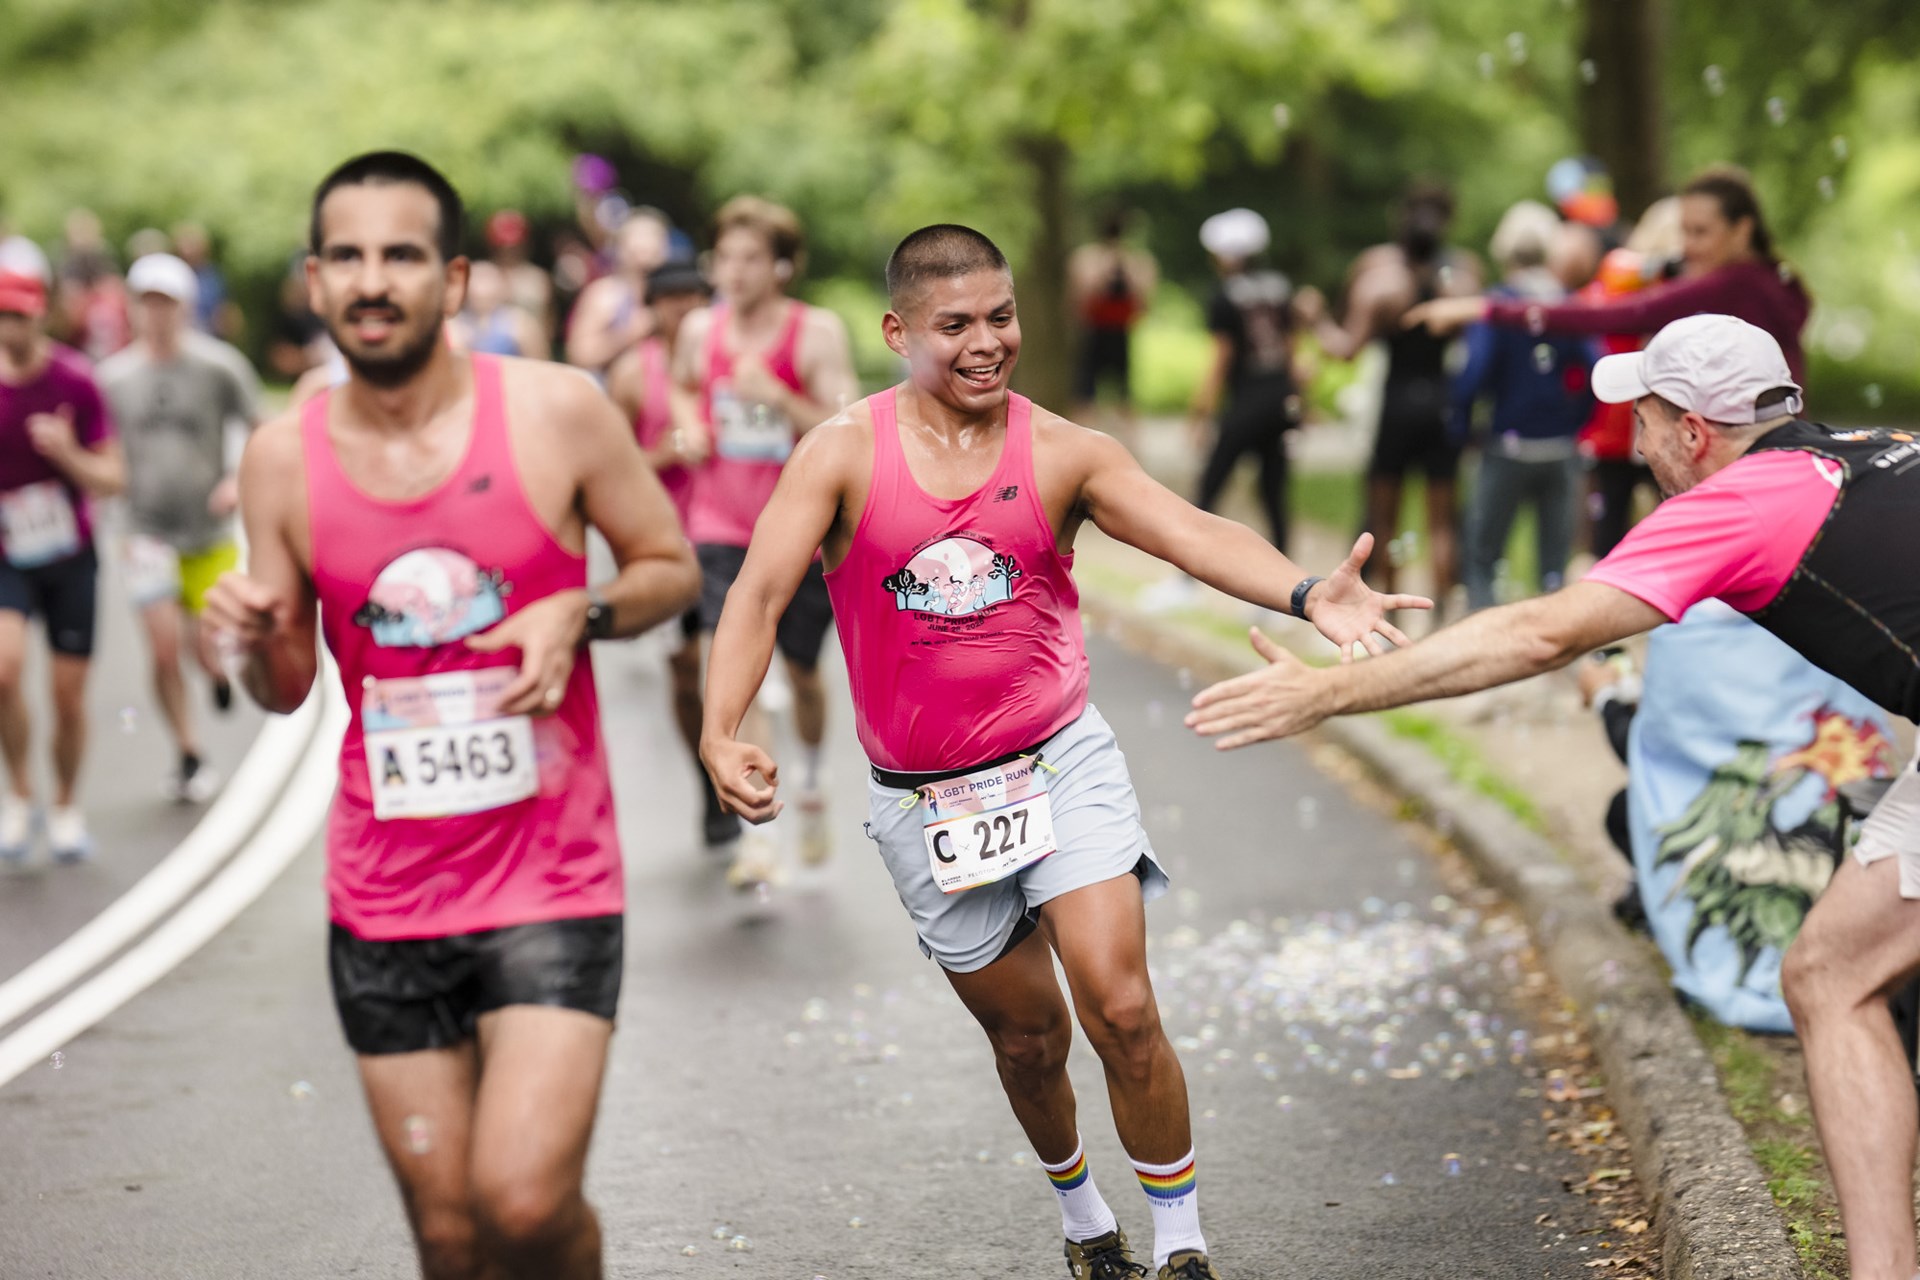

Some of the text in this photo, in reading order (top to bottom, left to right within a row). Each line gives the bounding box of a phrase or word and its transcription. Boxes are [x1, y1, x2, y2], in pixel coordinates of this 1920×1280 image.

[913, 605, 998, 626] LGBT PRIDE RUN
[927, 624, 948, 633] JUNE
[382, 730, 516, 786] A 5463
[938, 785, 965, 799] LGBT
[968, 775, 1003, 792] PRIDE
[1005, 768, 1028, 782] RUN
[933, 808, 1029, 863] C 227
